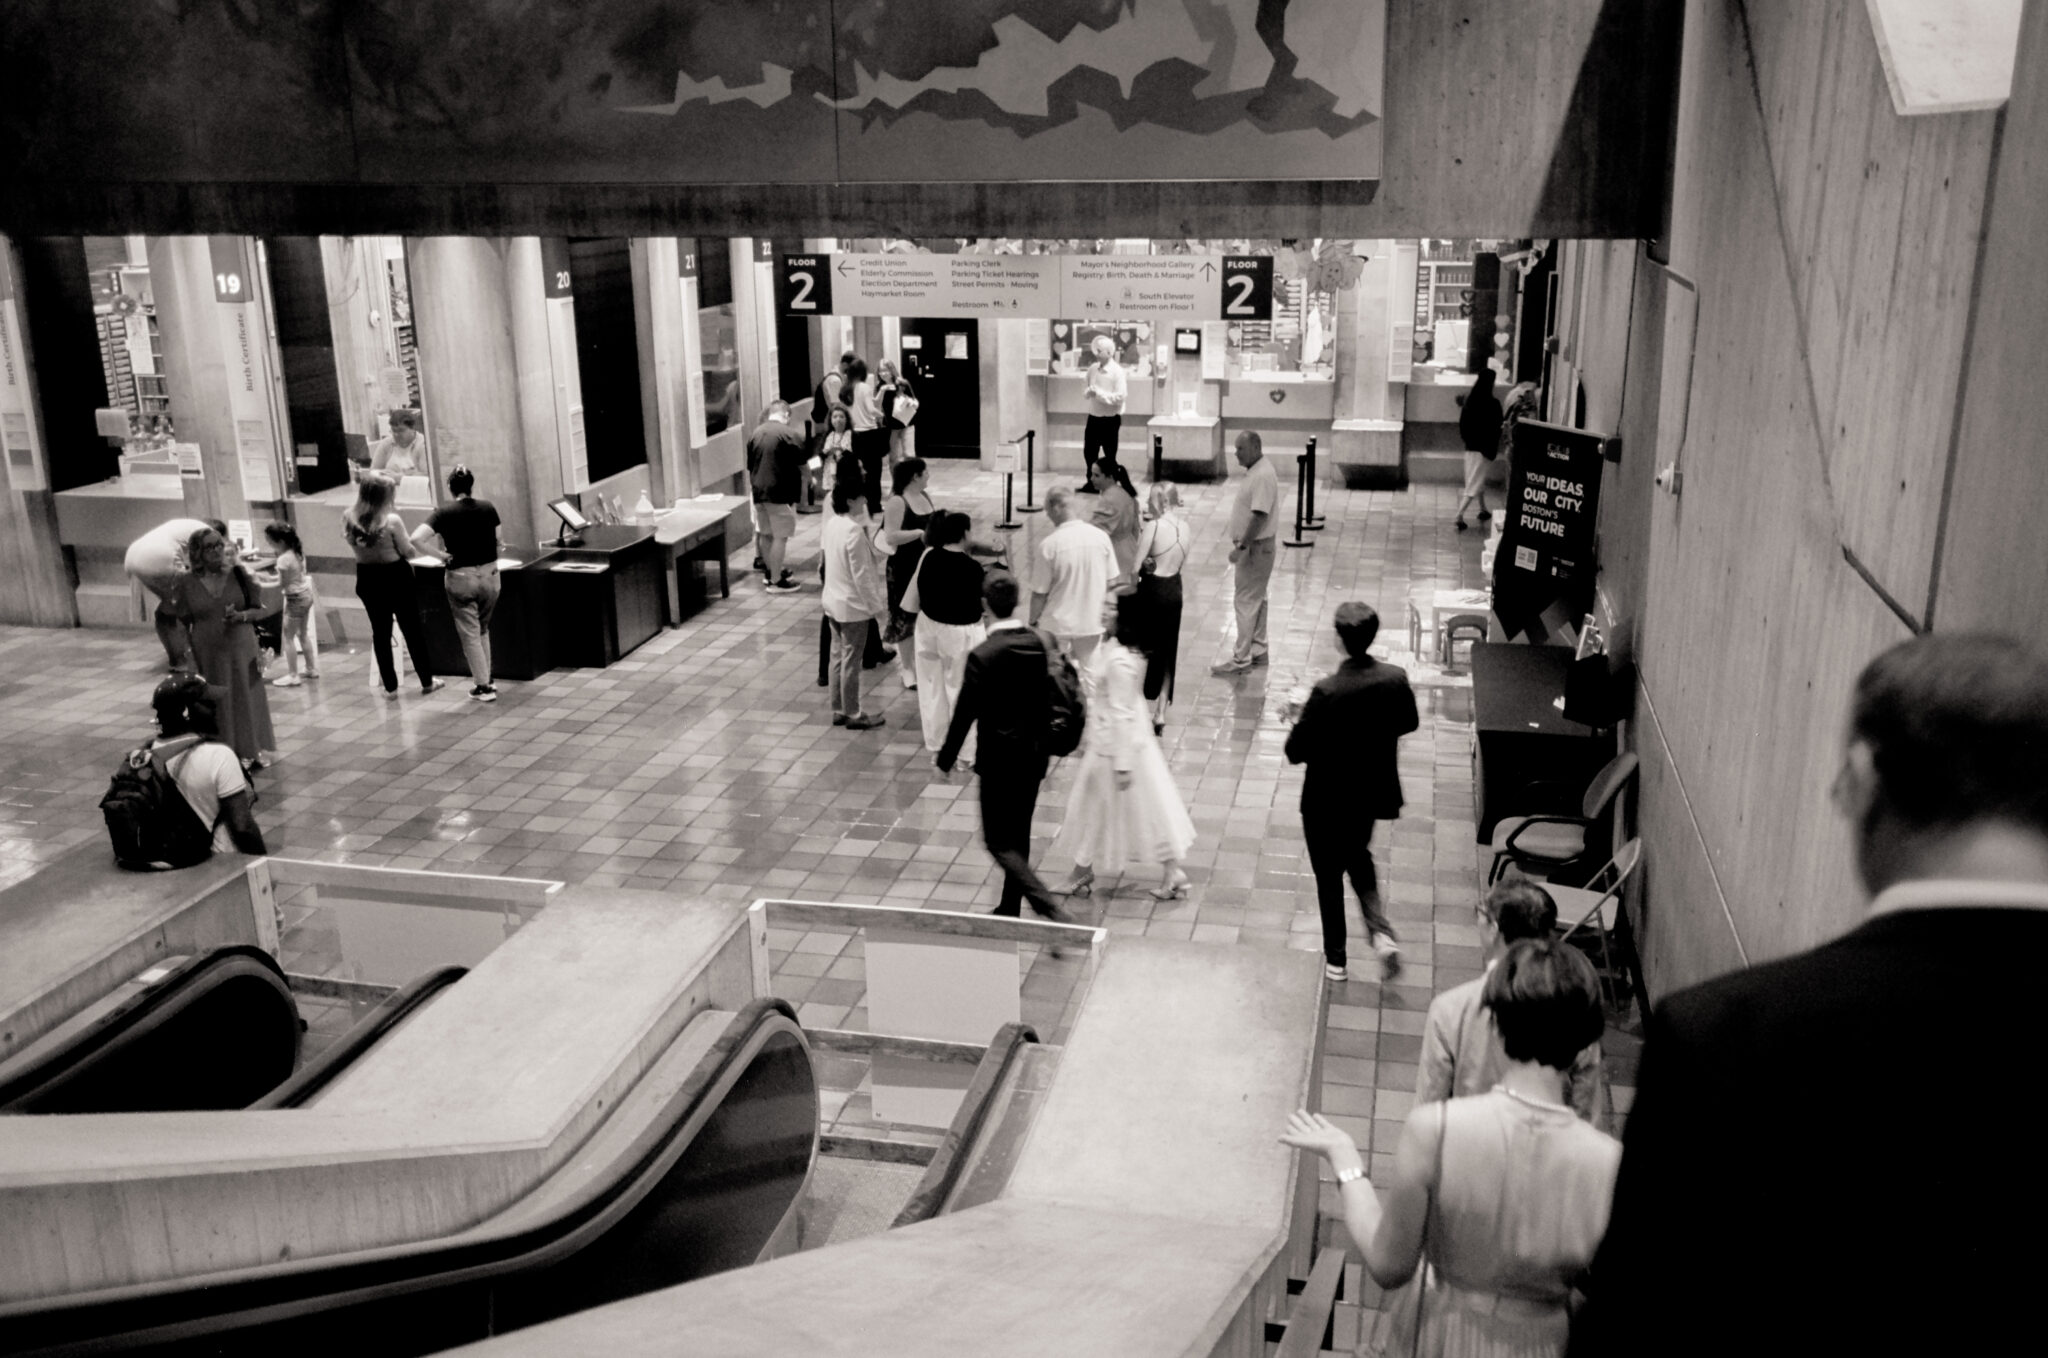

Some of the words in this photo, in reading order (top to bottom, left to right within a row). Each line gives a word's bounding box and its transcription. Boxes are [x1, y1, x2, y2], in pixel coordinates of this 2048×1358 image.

[762, 241, 772, 256] 22
[685, 254, 695, 270] 21
[788, 258, 816, 267] FLOOR
[860, 259, 883, 267] Credit
[885, 259, 907, 267] Union
[951, 260, 980, 268] Parking
[1080, 261, 1109, 269] Mayor's
[1111, 261, 1167, 269] Neighborhood
[1168, 261, 1195, 269] Gallery
[1227, 260, 1258, 269] FLOOR
[556, 271, 570, 289] 20
[861, 269, 886, 278] Elderly
[951, 270, 980, 278] Parking
[982, 270, 1004, 278] Ticket
[1006, 271, 1040, 279] Hearings
[216, 273, 241, 294] 19
[789, 271, 817, 309] 2
[893, 280, 938, 288] Department
[952, 280, 975, 288] Street
[1010, 281, 1039, 290] Moving
[861, 290, 902, 298] Haymarket
[1227, 274, 1255, 314] 2
[237, 312, 250, 365] Certificate
[5, 361, 16, 386] Birth
[244, 366, 254, 392] Birth
[1526, 471, 1546, 483] YOUR
[1523, 487, 1548, 504] OUR
[1522, 502, 1558, 520] BOSTON'S
[1520, 514, 1565, 537] FUTURE
